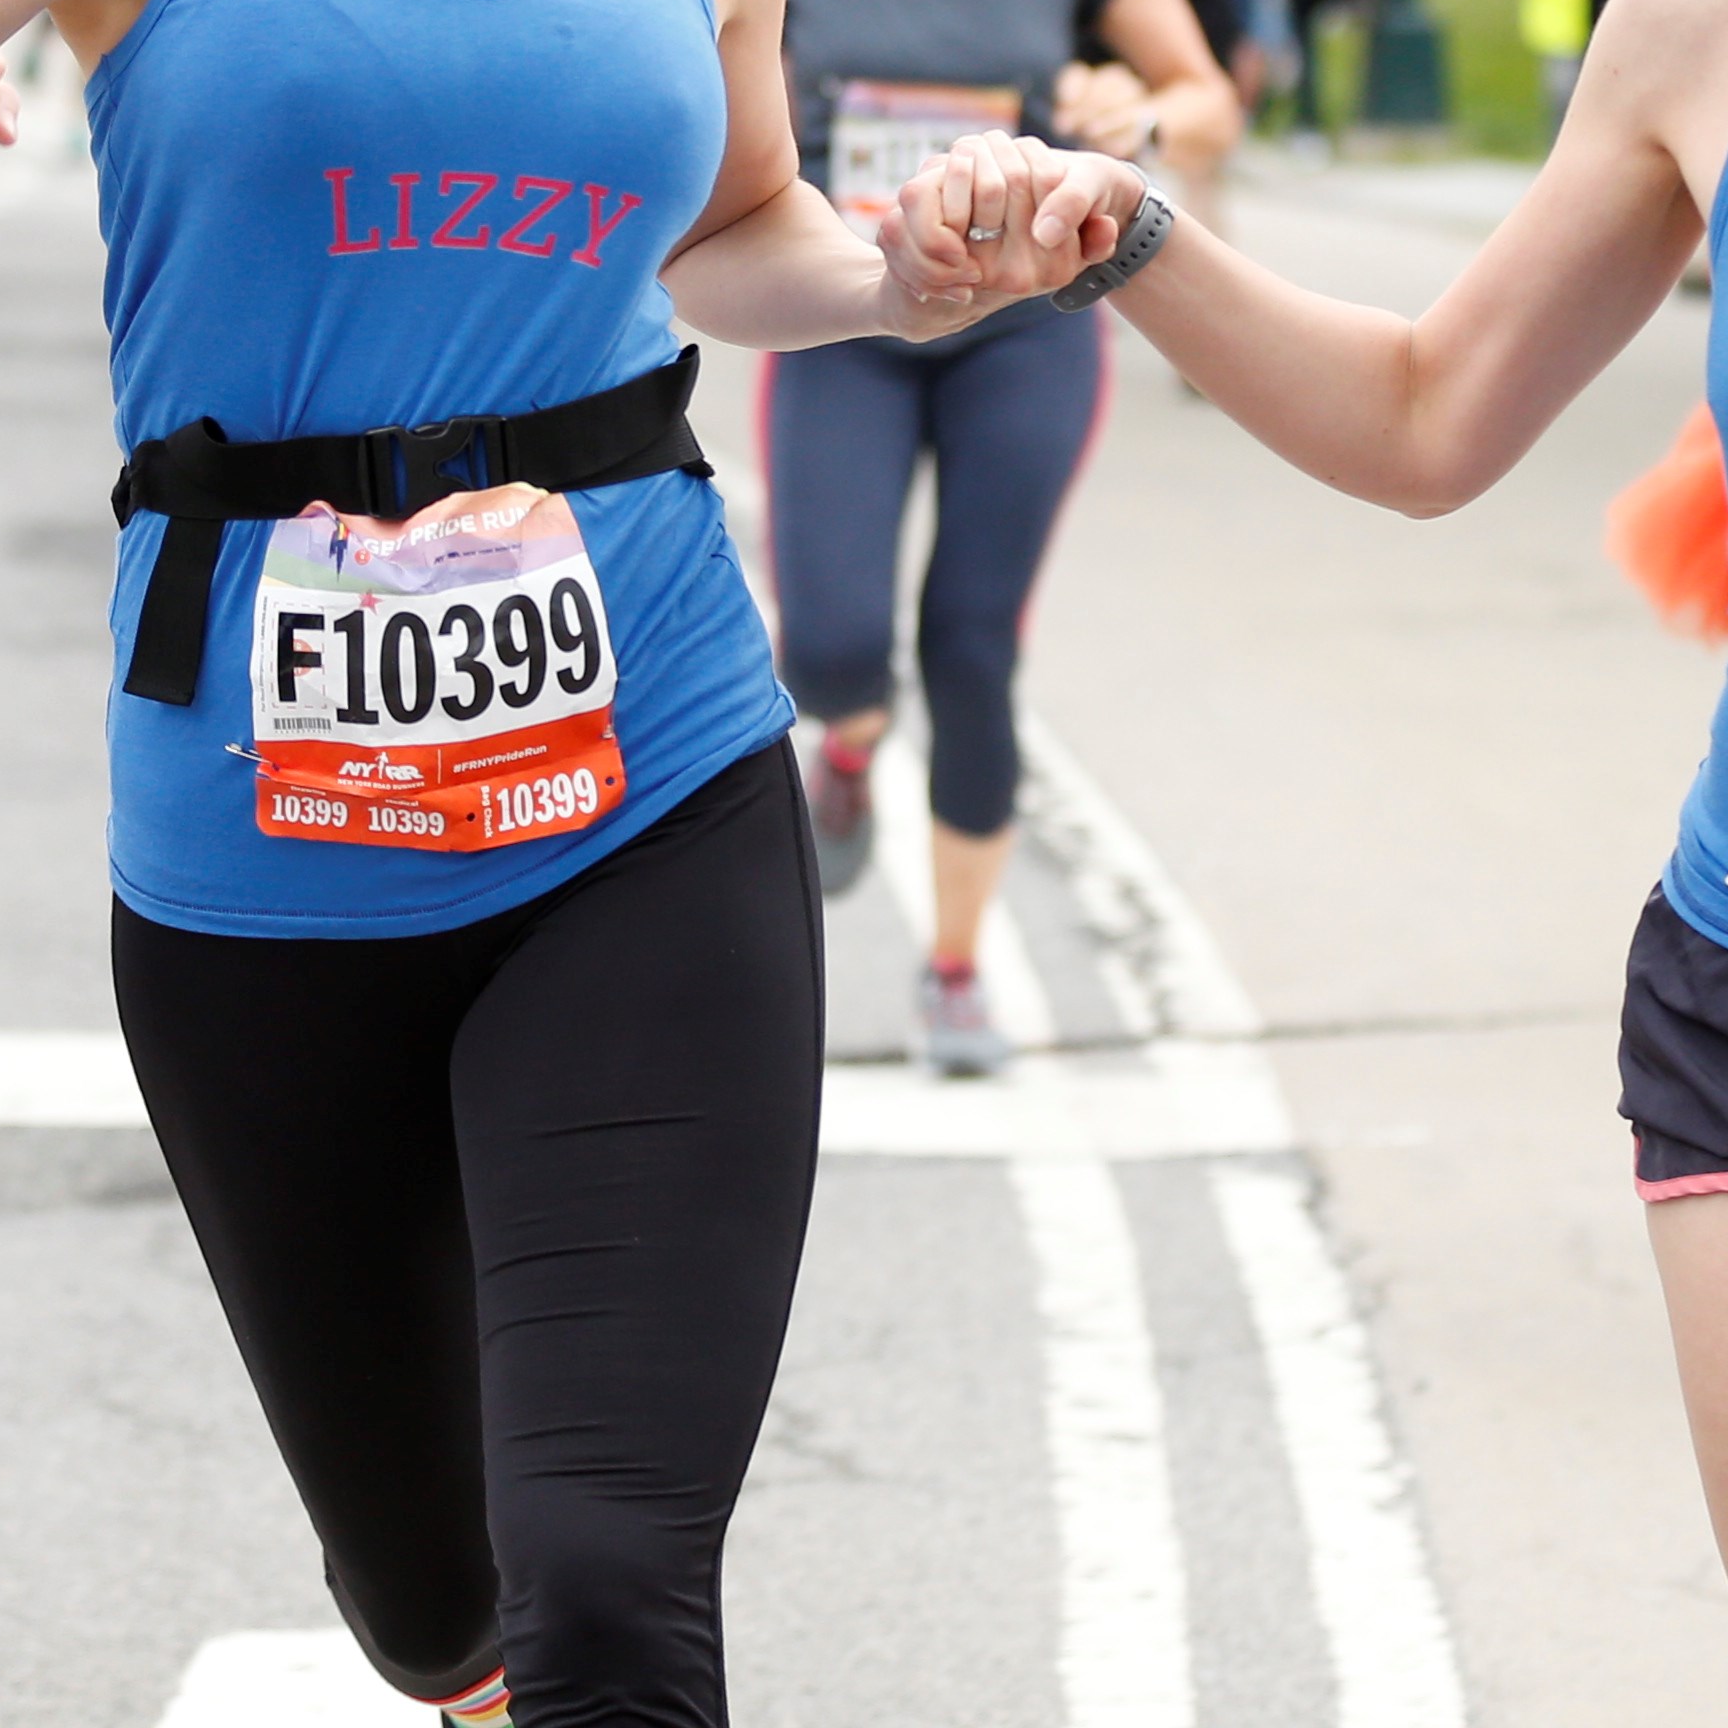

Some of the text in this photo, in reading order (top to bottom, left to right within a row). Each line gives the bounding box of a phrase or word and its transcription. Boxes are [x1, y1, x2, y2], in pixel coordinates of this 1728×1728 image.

[325, 168, 643, 268] LIZZY
[410, 516, 477, 546] PRIDE
[453, 745, 547, 773] #FRNYPrideRun
[272, 794, 348, 828] 10399
[480, 785, 494, 839] Bag Check
[497, 768, 598, 832] 10399
[368, 806, 445, 837] 10399
